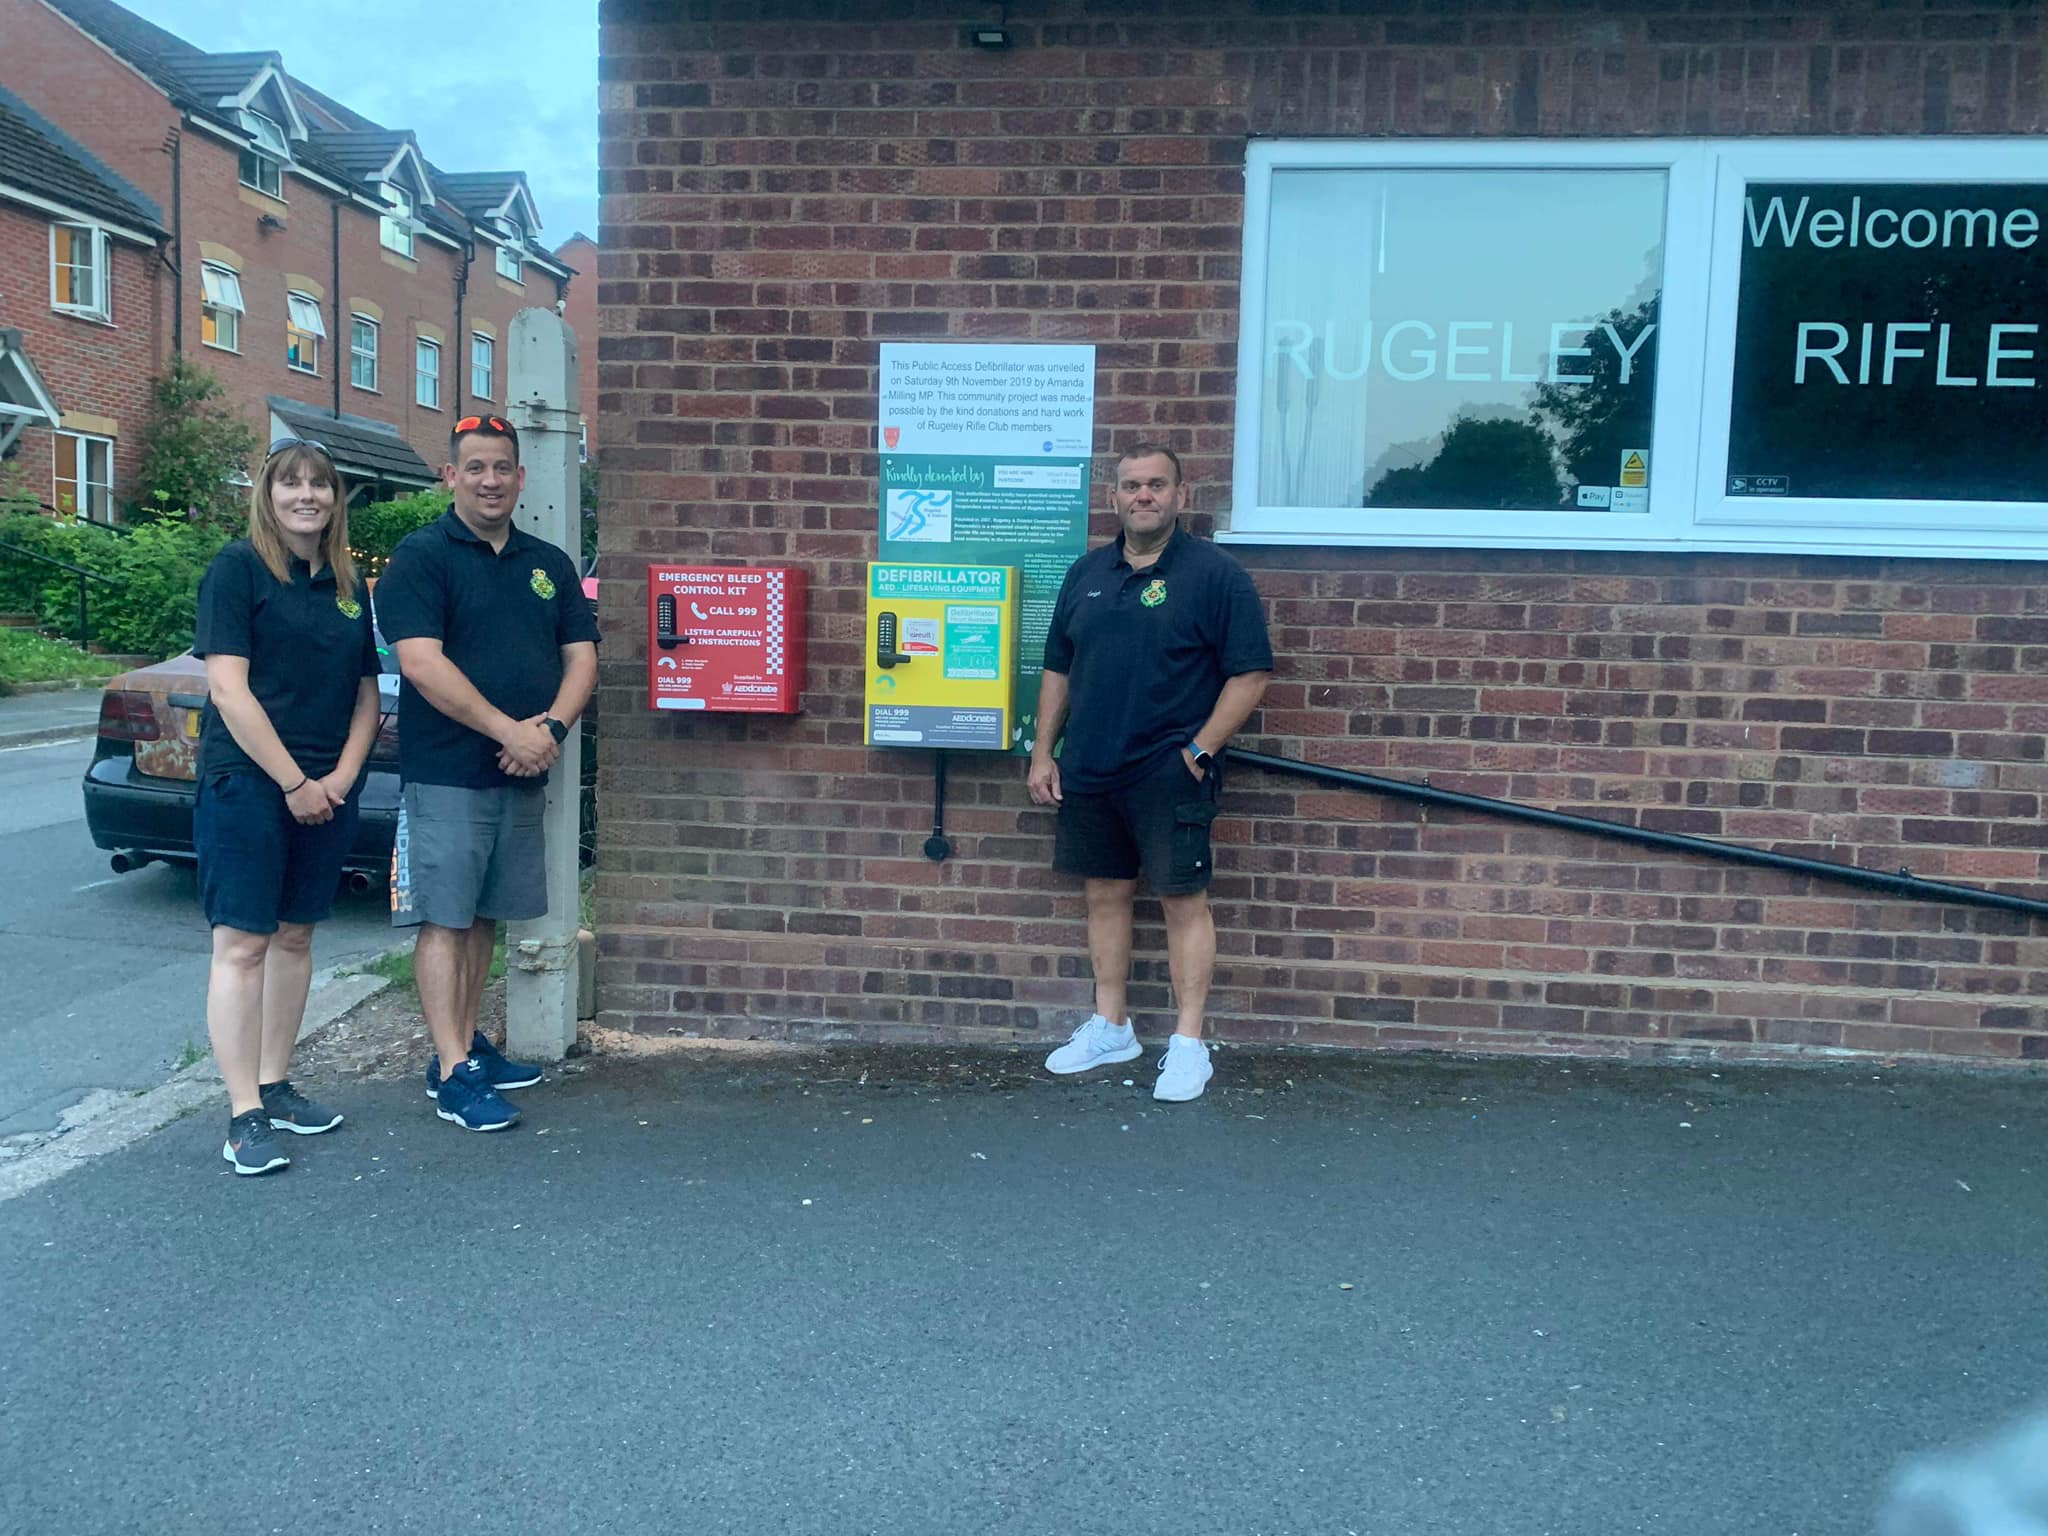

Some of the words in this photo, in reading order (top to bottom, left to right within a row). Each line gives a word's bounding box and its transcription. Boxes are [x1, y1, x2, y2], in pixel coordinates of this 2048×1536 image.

[1744, 195, 2040, 249] Welcome
[1264, 319, 1657, 385] RUGELEY
[1794, 321, 2040, 388] RIFLE
[891, 361, 910, 371] This
[912, 361, 939, 371] Public
[941, 361, 972, 371] Access
[974, 361, 1025, 372] Defibrillator
[1027, 364, 1045, 372] was
[1047, 362, 1085, 373] unveiled
[890, 377, 902, 385] on
[904, 375, 943, 388] Saturday
[945, 376, 960, 386] 9th
[962, 376, 1008, 386] November
[1009, 377, 1032, 387] 2019
[1034, 377, 1045, 389] by
[1047, 377, 1085, 388] Amanda
[888, 390, 916, 403] Milling
[938, 391, 956, 401] This
[959, 392, 1006, 403] community
[1008, 393, 1038, 404] project
[1041, 394, 1058, 402] was
[1060, 393, 1085, 402] made
[888, 406, 925, 416] possible
[927, 406, 937, 417] by
[940, 406, 953, 415] the
[956, 406, 974, 416] kind
[976, 407, 1019, 417] donations
[1022, 407, 1038, 417] and
[1041, 407, 1061, 417] hard
[1063, 408, 1085, 417] work
[916, 420, 926, 430] of
[928, 420, 964, 433] Rugeley
[966, 421, 986, 431] Rifle
[988, 421, 1009, 432] Club
[886, 464, 922, 489] Kindly
[925, 464, 967, 482] donated
[969, 466, 984, 489] by
[1755, 478, 1779, 486] CCTV
[658, 572, 725, 583] EMERGENCY
[727, 574, 762, 584] BLEED
[878, 568, 1001, 585] DEFIBRILLATOR
[673, 585, 725, 595] CONTROL
[727, 586, 748, 596] KIT
[879, 583, 896, 591] AED
[902, 584, 950, 593] LIFESAVING
[952, 585, 1001, 593] EQUIPMENT
[709, 606, 735, 616] CALL
[737, 606, 758, 616] 999
[684, 628, 714, 637] LISTEN
[716, 629, 763, 638] CAREFULLY
[698, 638, 761, 647] INSTRUCTIONS
[657, 676, 675, 684] DIAL
[676, 676, 692, 685] 999
[874, 708, 893, 716] DIAL
[893, 709, 910, 717] 999
